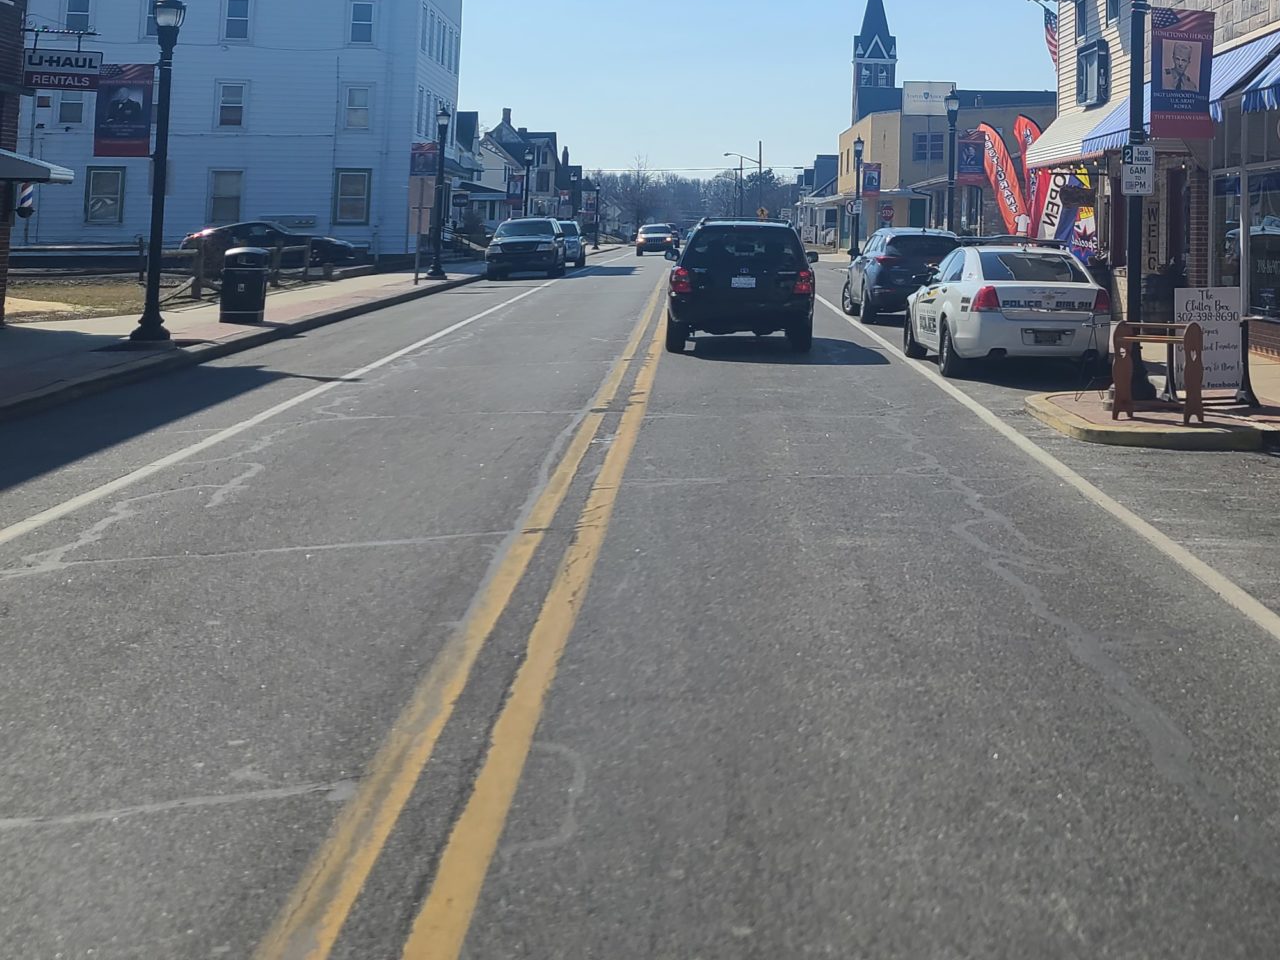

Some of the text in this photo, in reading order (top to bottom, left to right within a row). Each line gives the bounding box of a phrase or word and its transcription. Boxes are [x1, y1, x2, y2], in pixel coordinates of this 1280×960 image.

[28, 55, 98, 69] U-HAUL
[32, 75, 90, 87] RENTALS
[1125, 149, 1132, 162] 2
[1130, 167, 1146, 175] 6AM
[882, 209, 893, 217] STOP
[1198, 289, 1213, 300] The
[1002, 300, 1042, 308] POLICE
[1185, 300, 1230, 312] Clutter Box
[1176, 311, 1239, 321] 302-398-8690
[1207, 380, 1240, 389] Facebook
